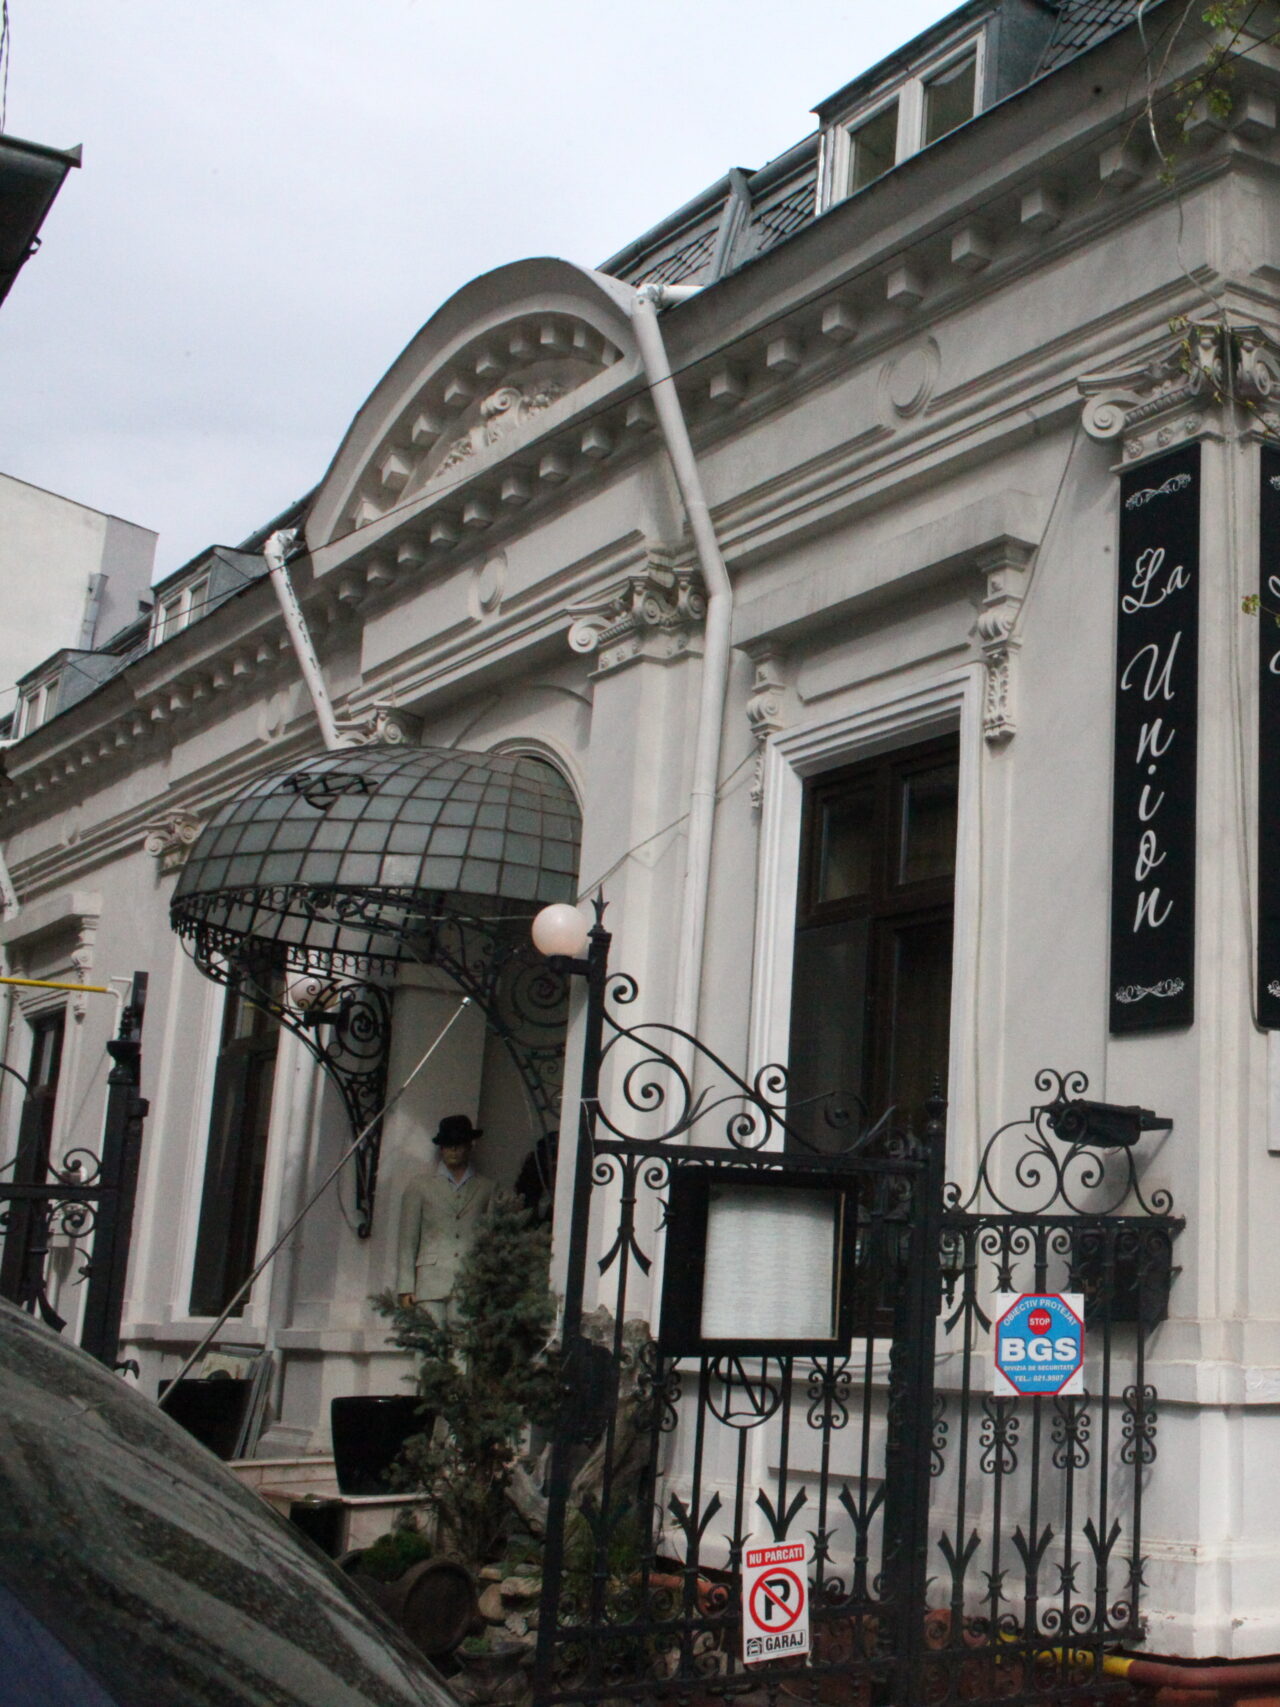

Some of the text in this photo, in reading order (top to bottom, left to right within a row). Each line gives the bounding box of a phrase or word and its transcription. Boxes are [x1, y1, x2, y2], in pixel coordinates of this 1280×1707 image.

[1122, 547, 1190, 614] La
[1003, 1299, 1077, 1326] OBIECTIV PROTEJAT
[1029, 1318, 1050, 1326] STOP
[1001, 1337, 1077, 1362] BGS
[749, 1547, 803, 1565] NU PARCATI
[765, 1632, 803, 1652] GARAJ
